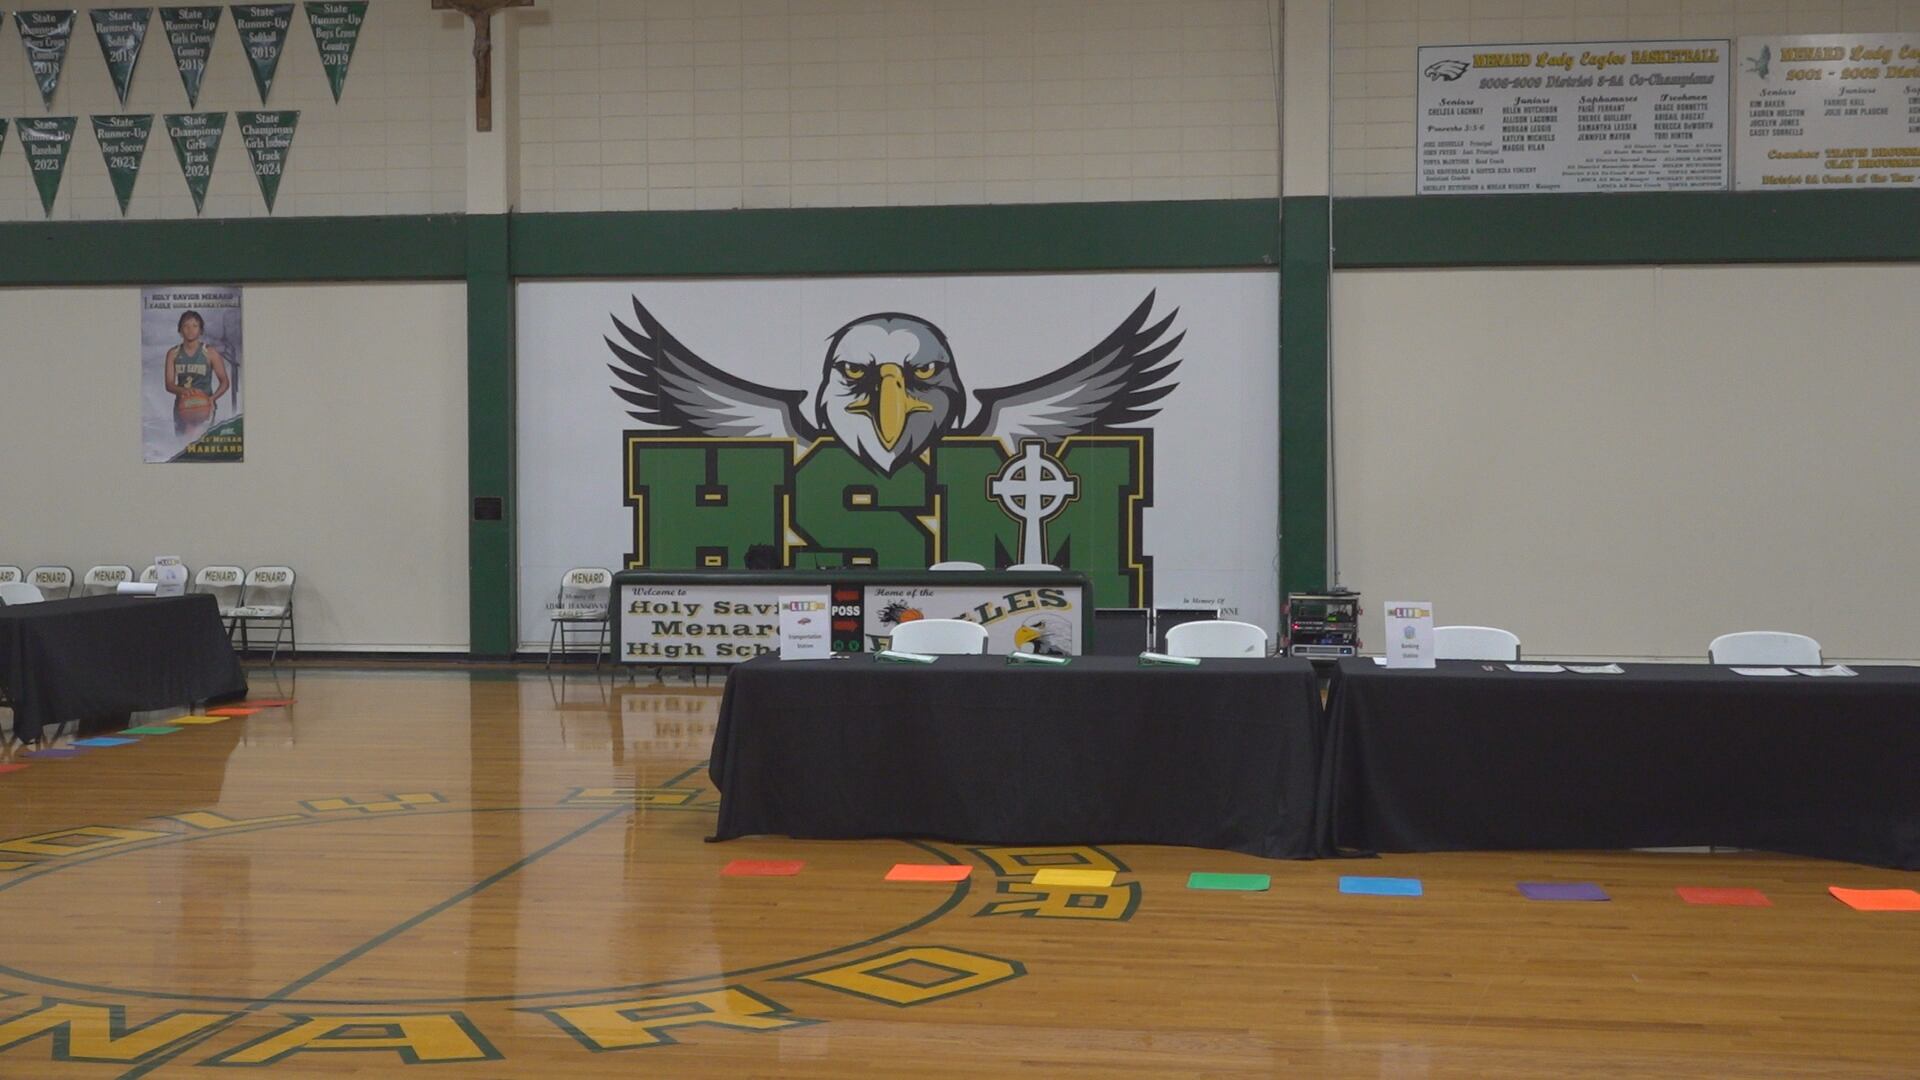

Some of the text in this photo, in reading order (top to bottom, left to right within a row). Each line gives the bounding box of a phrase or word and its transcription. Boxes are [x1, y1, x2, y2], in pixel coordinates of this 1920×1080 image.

[179, 9, 202, 19] State
[251, 7, 274, 17] State
[324, 4, 347, 13] State
[32, 13, 56, 23] State
[109, 11, 132, 21] State
[311, 14, 361, 26] Runner-Up
[97, 22, 146, 33] Runner-Up
[166, 20, 215, 31] Runner-Up
[238, 18, 287, 29] Runner-Up
[251, 47, 276, 58] 2019
[1780, 46, 1845, 62] MENARD
[1849, 44, 1893, 64] Lady
[323, 54, 348, 65] 2019
[1473, 49, 1719, 70] MENARD Lady Eagles BASKETBALL
[33, 62, 60, 74] 2018
[110, 117, 135, 127] State
[184, 116, 207, 126] State
[256, 113, 279, 124] State
[34, 119, 58, 130] State
[97, 128, 147, 139] Runner-Up
[170, 127, 222, 139] Champions
[242, 125, 293, 136] Champions
[186, 139, 206, 150] Girls
[246, 138, 264, 148] Girls
[185, 153, 209, 164] Track
[257, 151, 280, 161] Track
[34, 159, 59, 170] 2023
[110, 156, 136, 168] 2023
[185, 165, 210, 177] 2024
[256, 163, 281, 175] 2024
[36, 571, 66, 583] MENARD
[94, 570, 126, 581] MENARD
[204, 570, 236, 582] MENARD
[255, 570, 287, 582] MENARD
[571, 573, 604, 584] MENARD
[631, 587, 687, 597] Welcome to
[874, 588, 934, 598] Home of the
[628, 601, 703, 617] Holy
[831, 606, 860, 616] POSS
[652, 620, 781, 636] Menar
[626, 643, 704, 658] High
